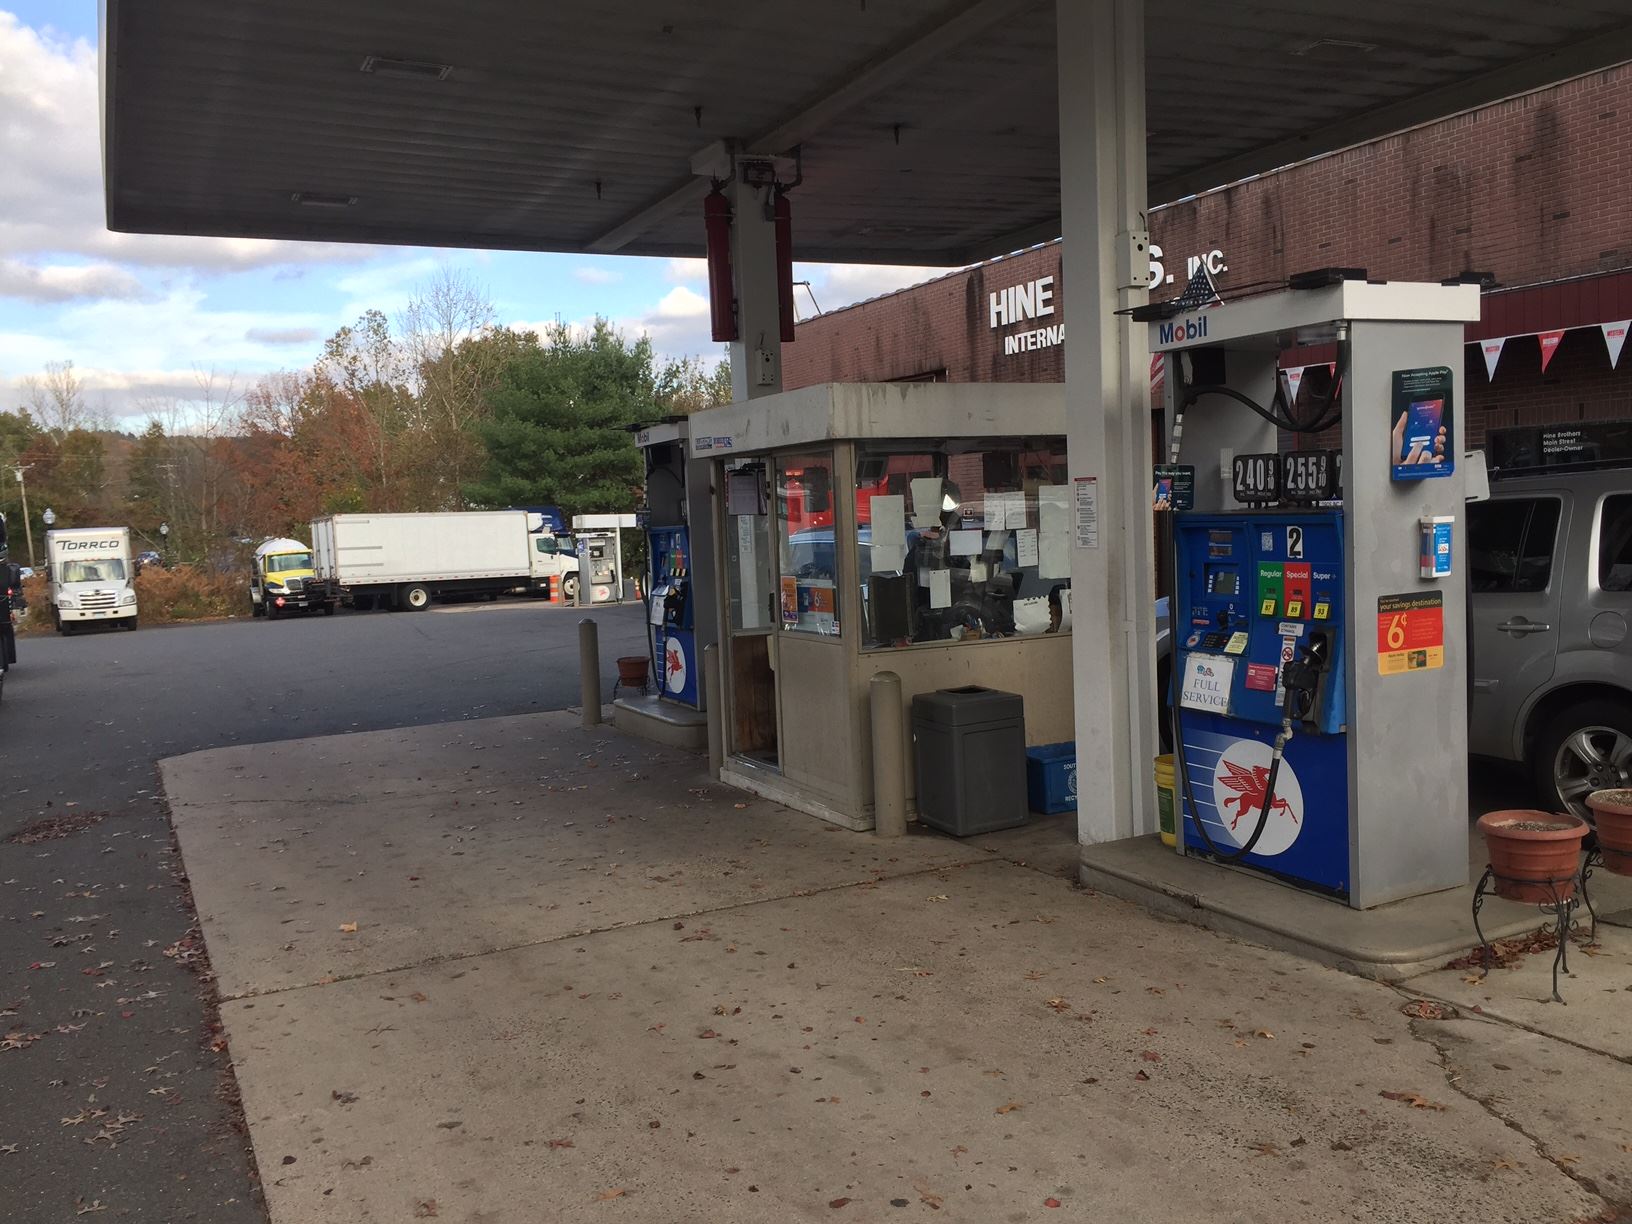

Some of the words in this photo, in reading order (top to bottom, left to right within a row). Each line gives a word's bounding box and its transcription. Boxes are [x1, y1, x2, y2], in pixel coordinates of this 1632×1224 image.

[1187, 250, 1228, 280] INC.
[990, 276, 1054, 328] HINE
[1159, 316, 1208, 345] Mobil
[56, 540, 119, 550] TORRCO
[1288, 527, 1302, 557] 2
[1260, 569, 1282, 578] Regular
[1286, 571, 1309, 579] Special
[1313, 572, 1331, 580] Super
[1380, 603, 1391, 612] your
[1411, 598, 1441, 607] destination
[1193, 678, 1220, 692] FULL
[1182, 690, 1228, 707] SERVICE
